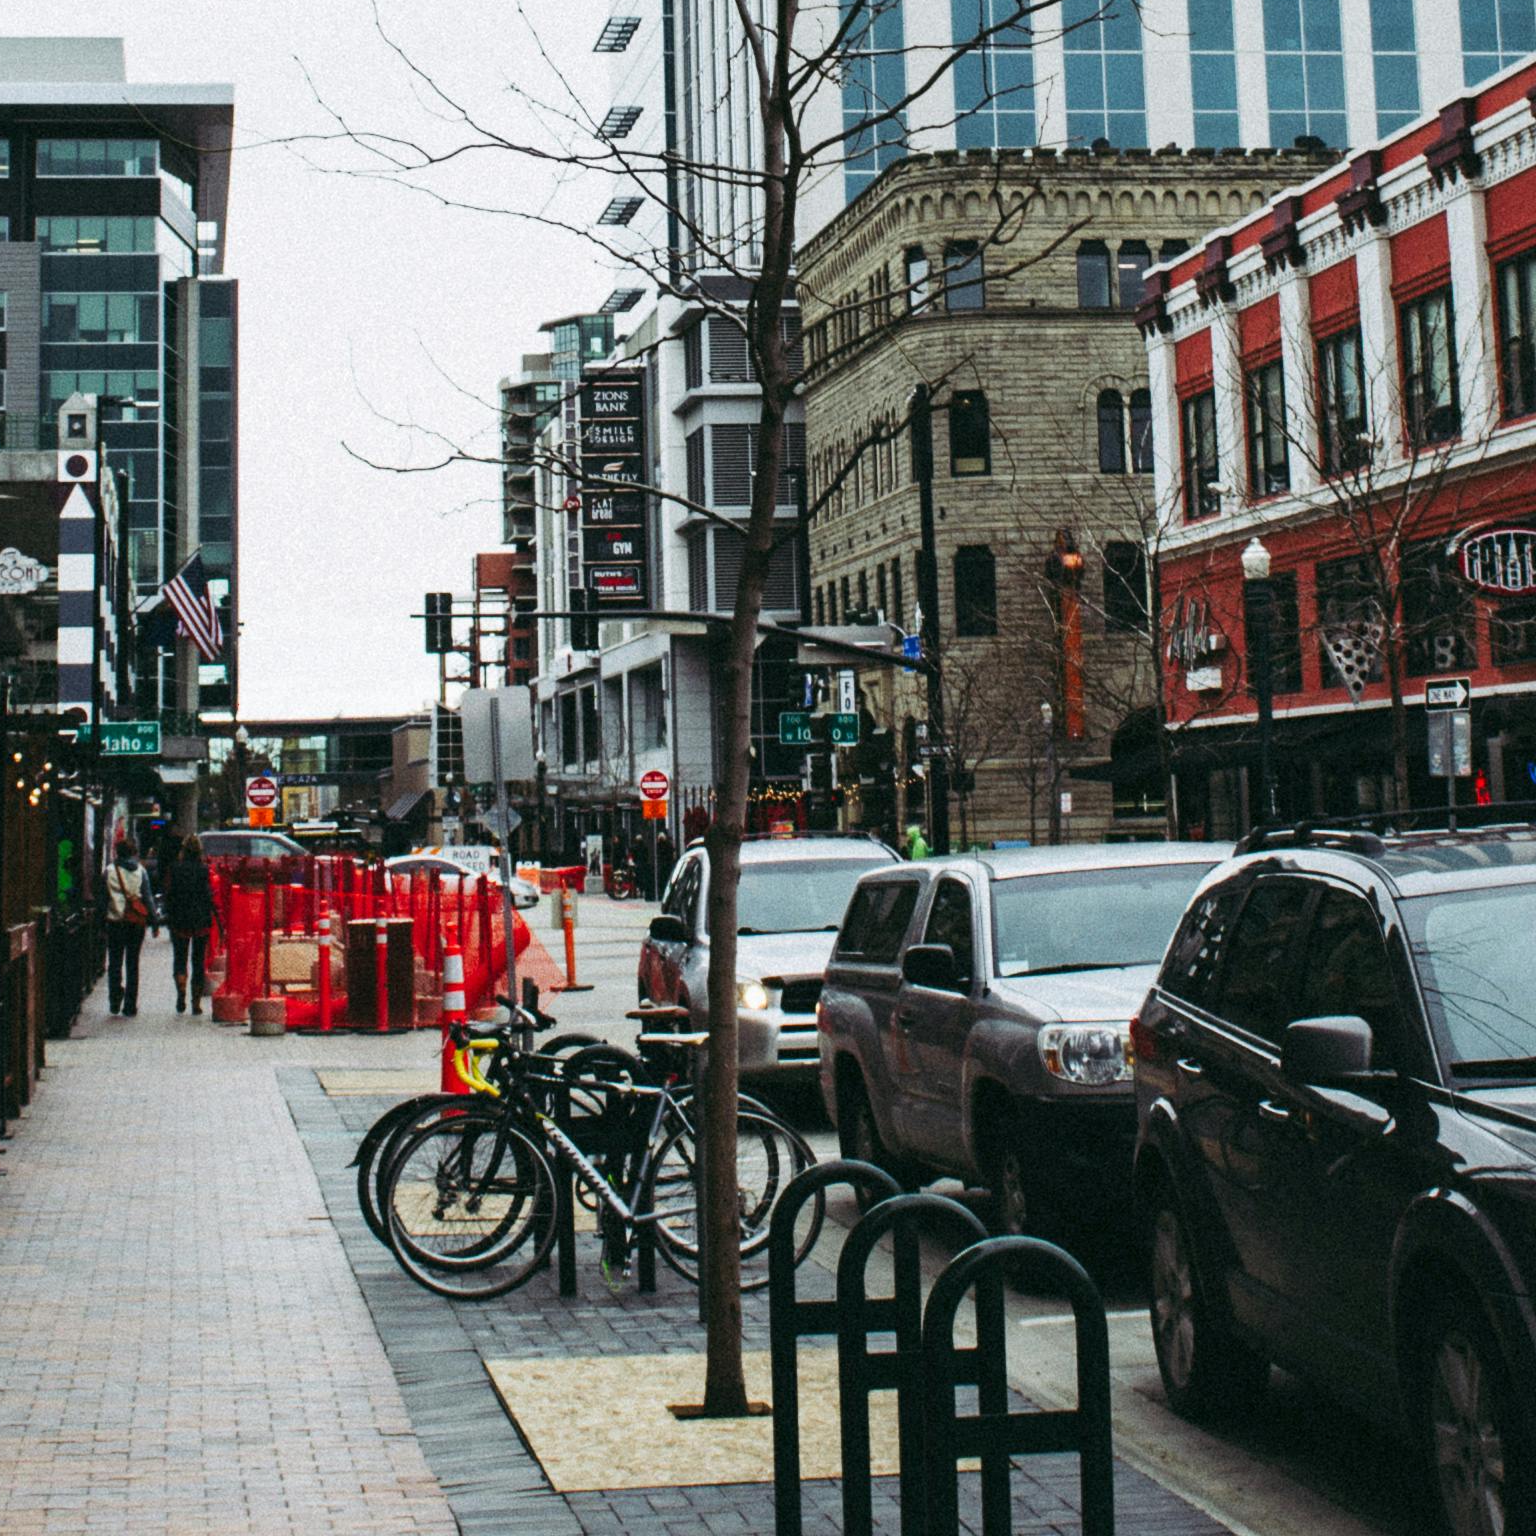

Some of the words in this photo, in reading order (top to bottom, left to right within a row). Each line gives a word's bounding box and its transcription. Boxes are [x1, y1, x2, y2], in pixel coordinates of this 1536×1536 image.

[593, 391, 629, 401] ZIONS
[595, 402, 628, 412] BANK
[594, 425, 633, 435] SMILE
[612, 542, 633, 555] GYM
[101, 734, 142, 752] daho
[453, 850, 481, 860] ROAD
